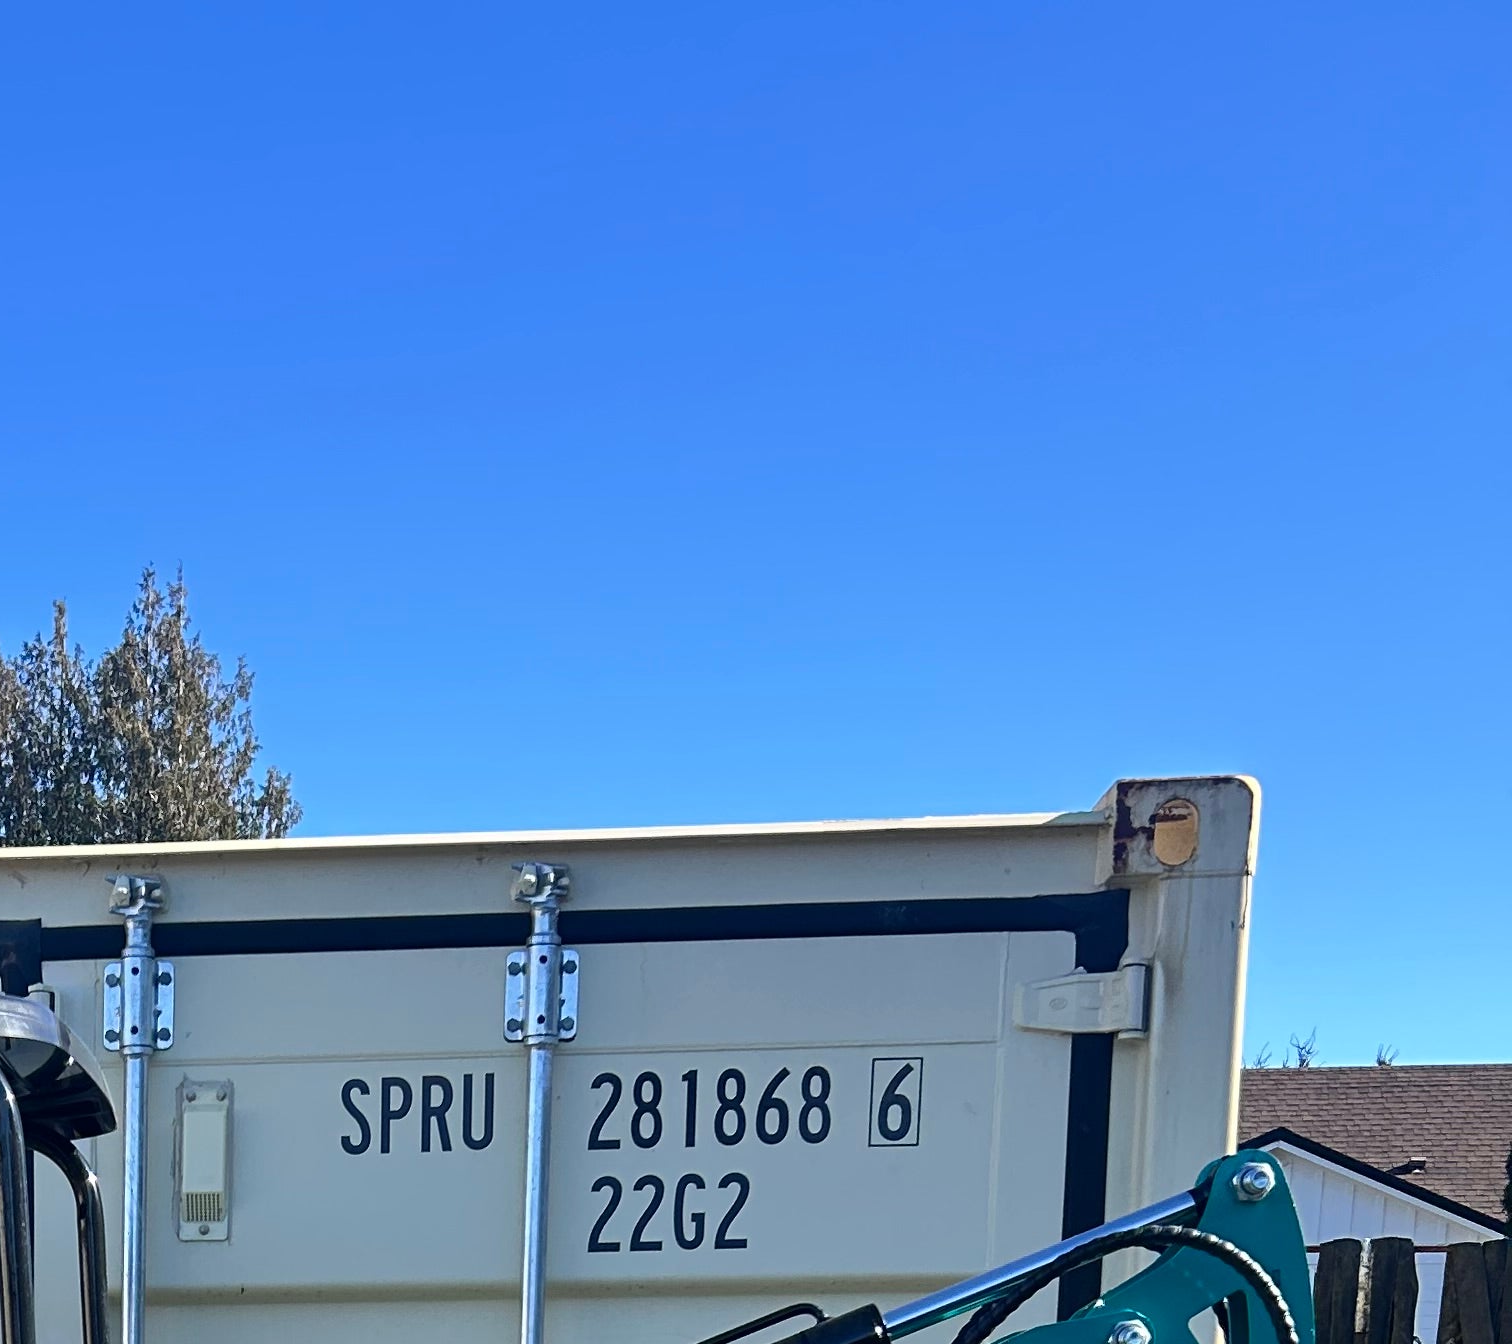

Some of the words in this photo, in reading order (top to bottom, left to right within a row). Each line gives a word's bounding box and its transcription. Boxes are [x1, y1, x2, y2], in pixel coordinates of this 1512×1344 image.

[341, 1073, 496, 1156] SPRU
[587, 1065, 832, 1151] 281868
[876, 1062, 915, 1142] 6
[587, 1172, 751, 1253] 22G2
